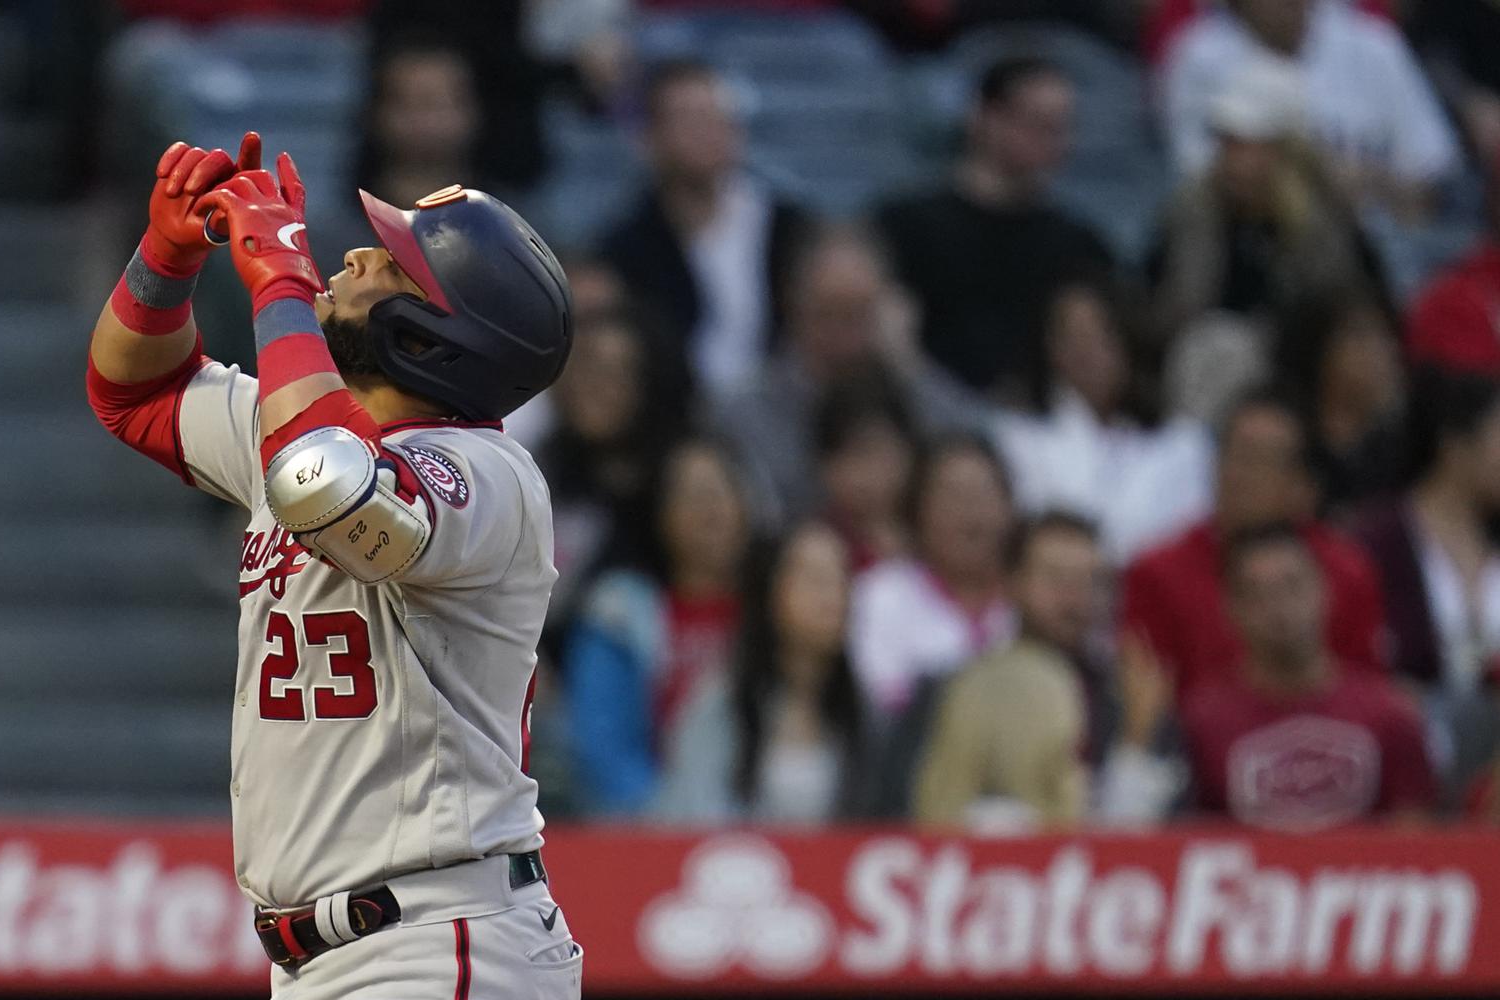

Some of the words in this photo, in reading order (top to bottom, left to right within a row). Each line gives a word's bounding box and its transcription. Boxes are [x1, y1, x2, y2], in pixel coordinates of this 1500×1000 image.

[348, 519, 368, 544] 23
[365, 530, 390, 562] Cruz
[259, 608, 379, 722] 23
